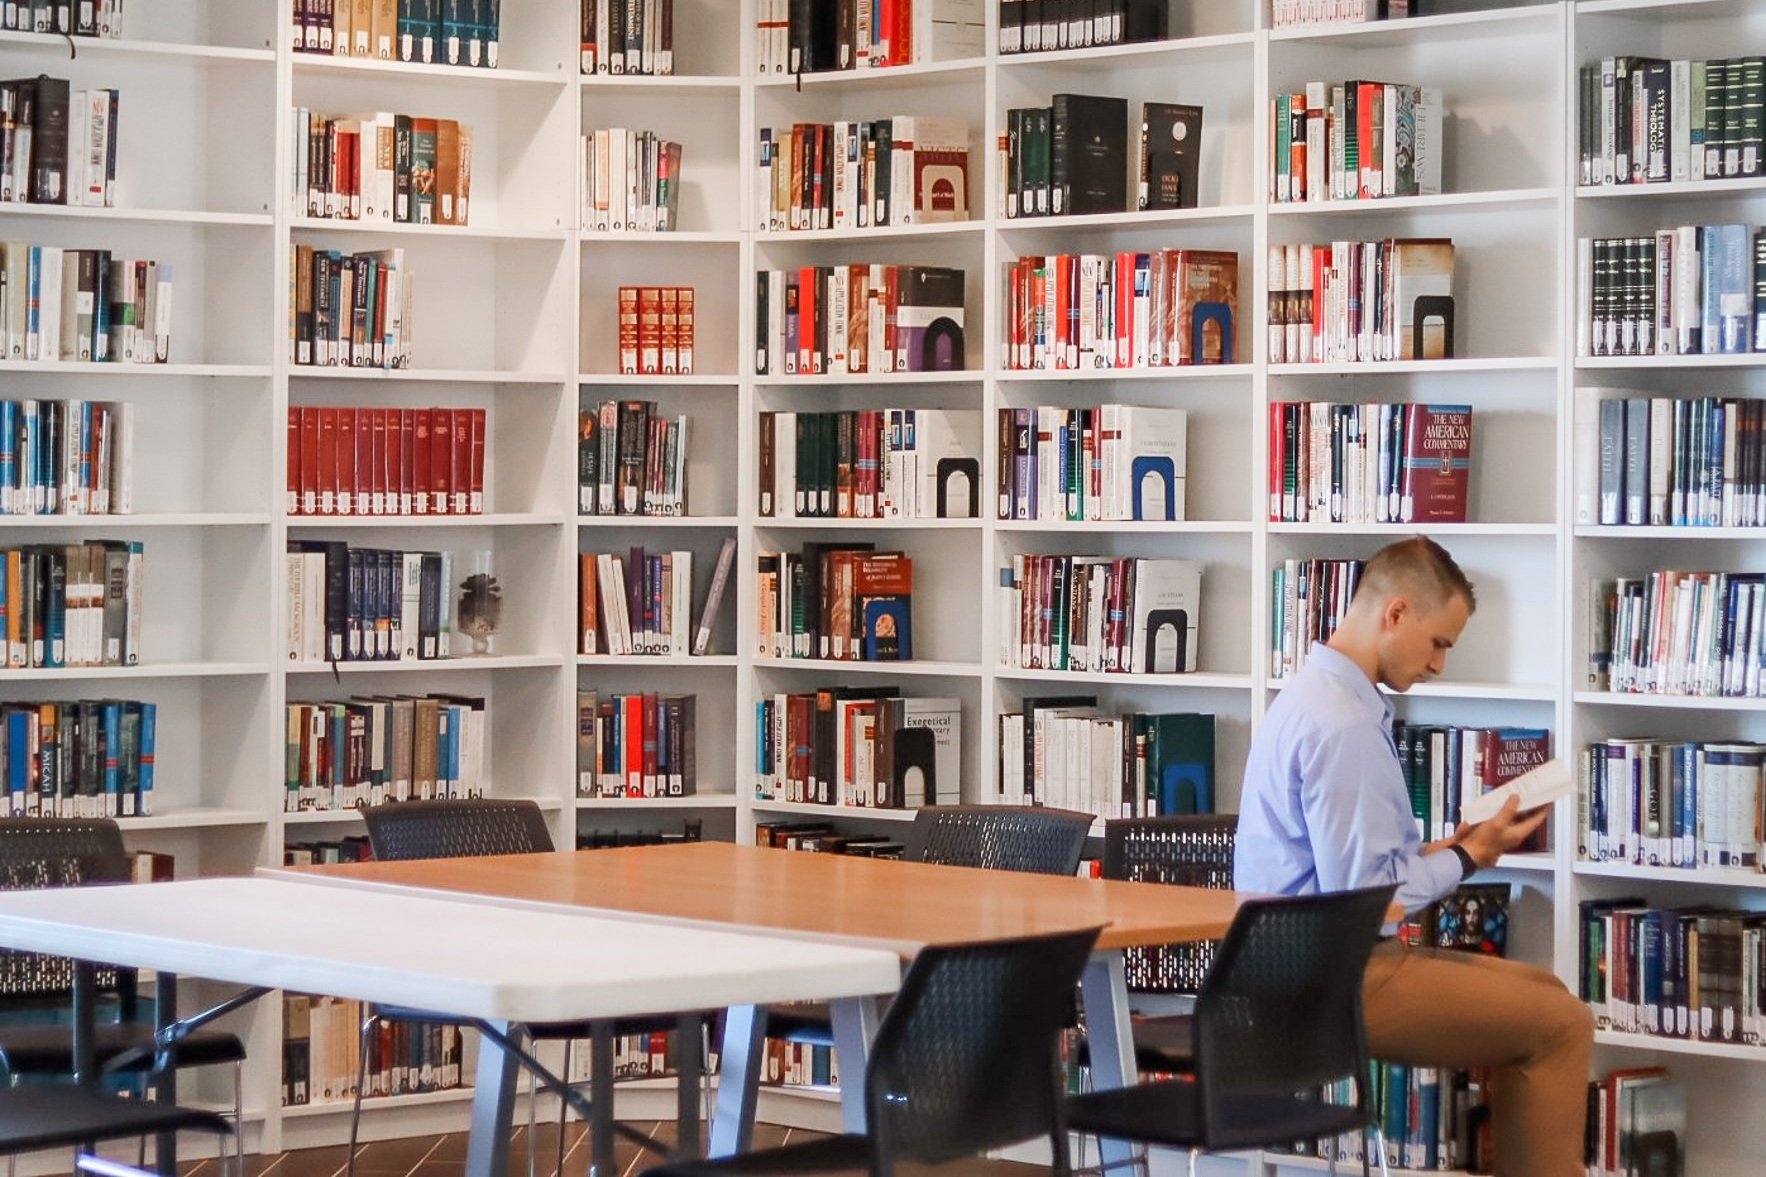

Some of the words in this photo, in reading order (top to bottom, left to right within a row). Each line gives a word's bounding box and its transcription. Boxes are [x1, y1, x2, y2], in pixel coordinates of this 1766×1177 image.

[1657, 89, 1665, 154] SYSTEMATIC
[1433, 414, 1447, 424] THE
[1449, 414, 1464, 424] NEW
[1424, 425, 1469, 438] AMERICAN
[1423, 439, 1467, 449] COMMENTARY
[907, 715, 951, 727] Exegetical
[1500, 751, 1544, 764] AMERICAN
[42, 751, 51, 792] MICAH
